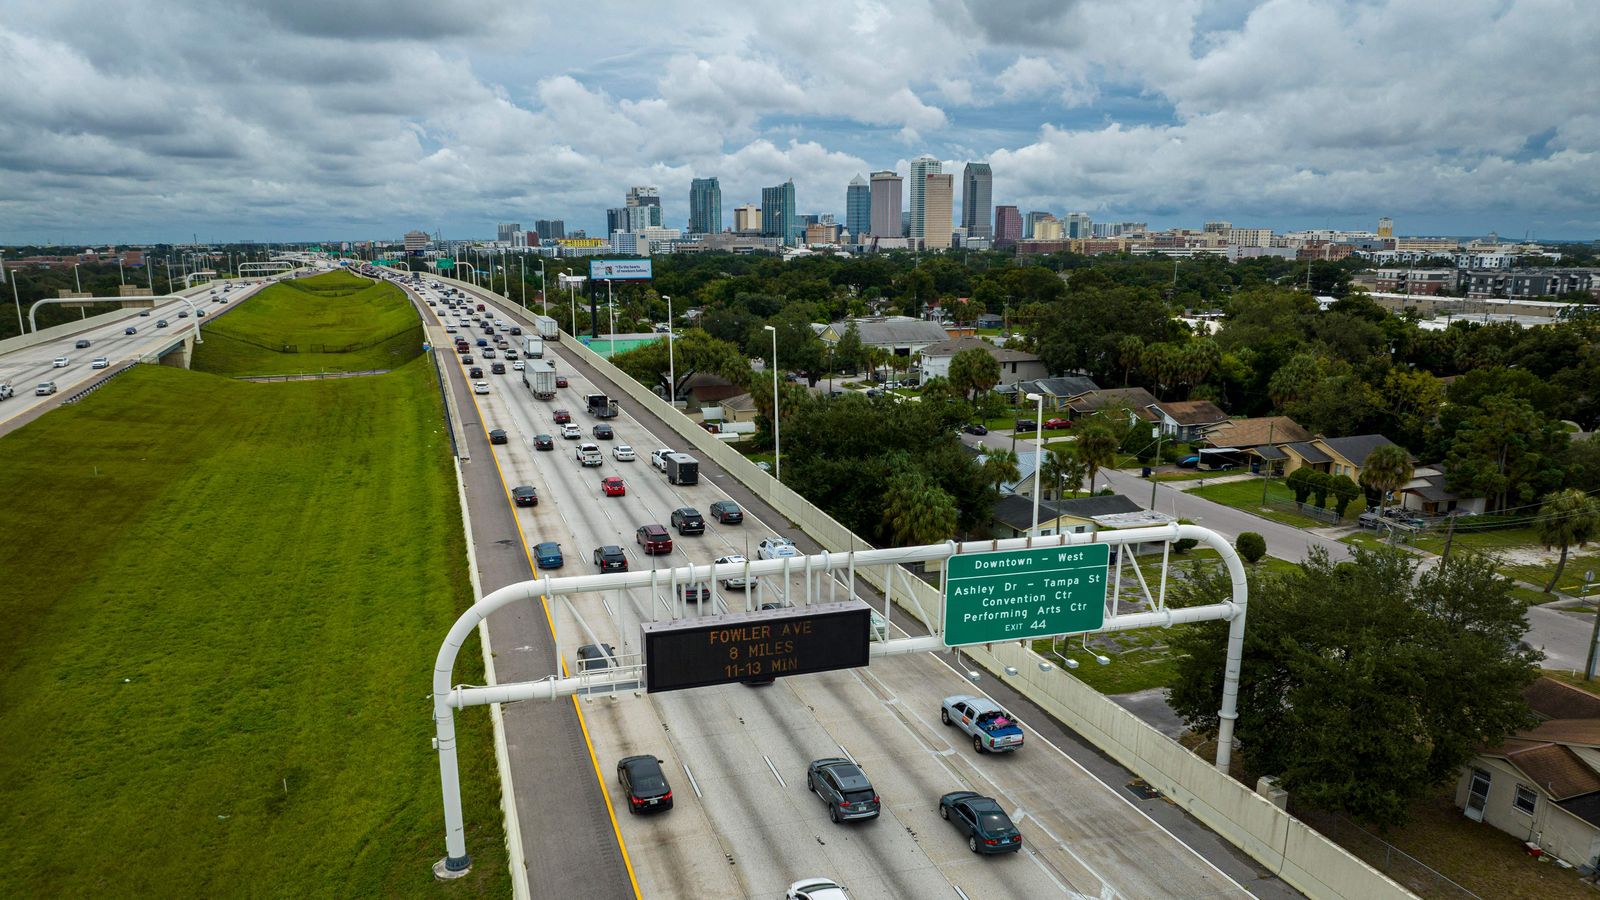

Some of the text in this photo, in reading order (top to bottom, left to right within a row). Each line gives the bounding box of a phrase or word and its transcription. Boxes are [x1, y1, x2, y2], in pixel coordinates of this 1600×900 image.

[975, 557, 1033, 569] Downtown
[1058, 551, 1084, 562] West
[954, 585, 995, 596] Ashley
[1004, 582, 1017, 592] Dr
[1043, 576, 1080, 588] Tampa
[1088, 574, 1100, 583] St
[982, 591, 1072, 607] Convention Ctr
[963, 602, 1087, 623] Performing Arts Ctr
[710, 620, 812, 645] FOWLER AVE
[1005, 620, 1047, 632] EXIT 44
[729, 640, 794, 660] 8 MILES
[724, 657, 798, 678] 11-13 MIN
